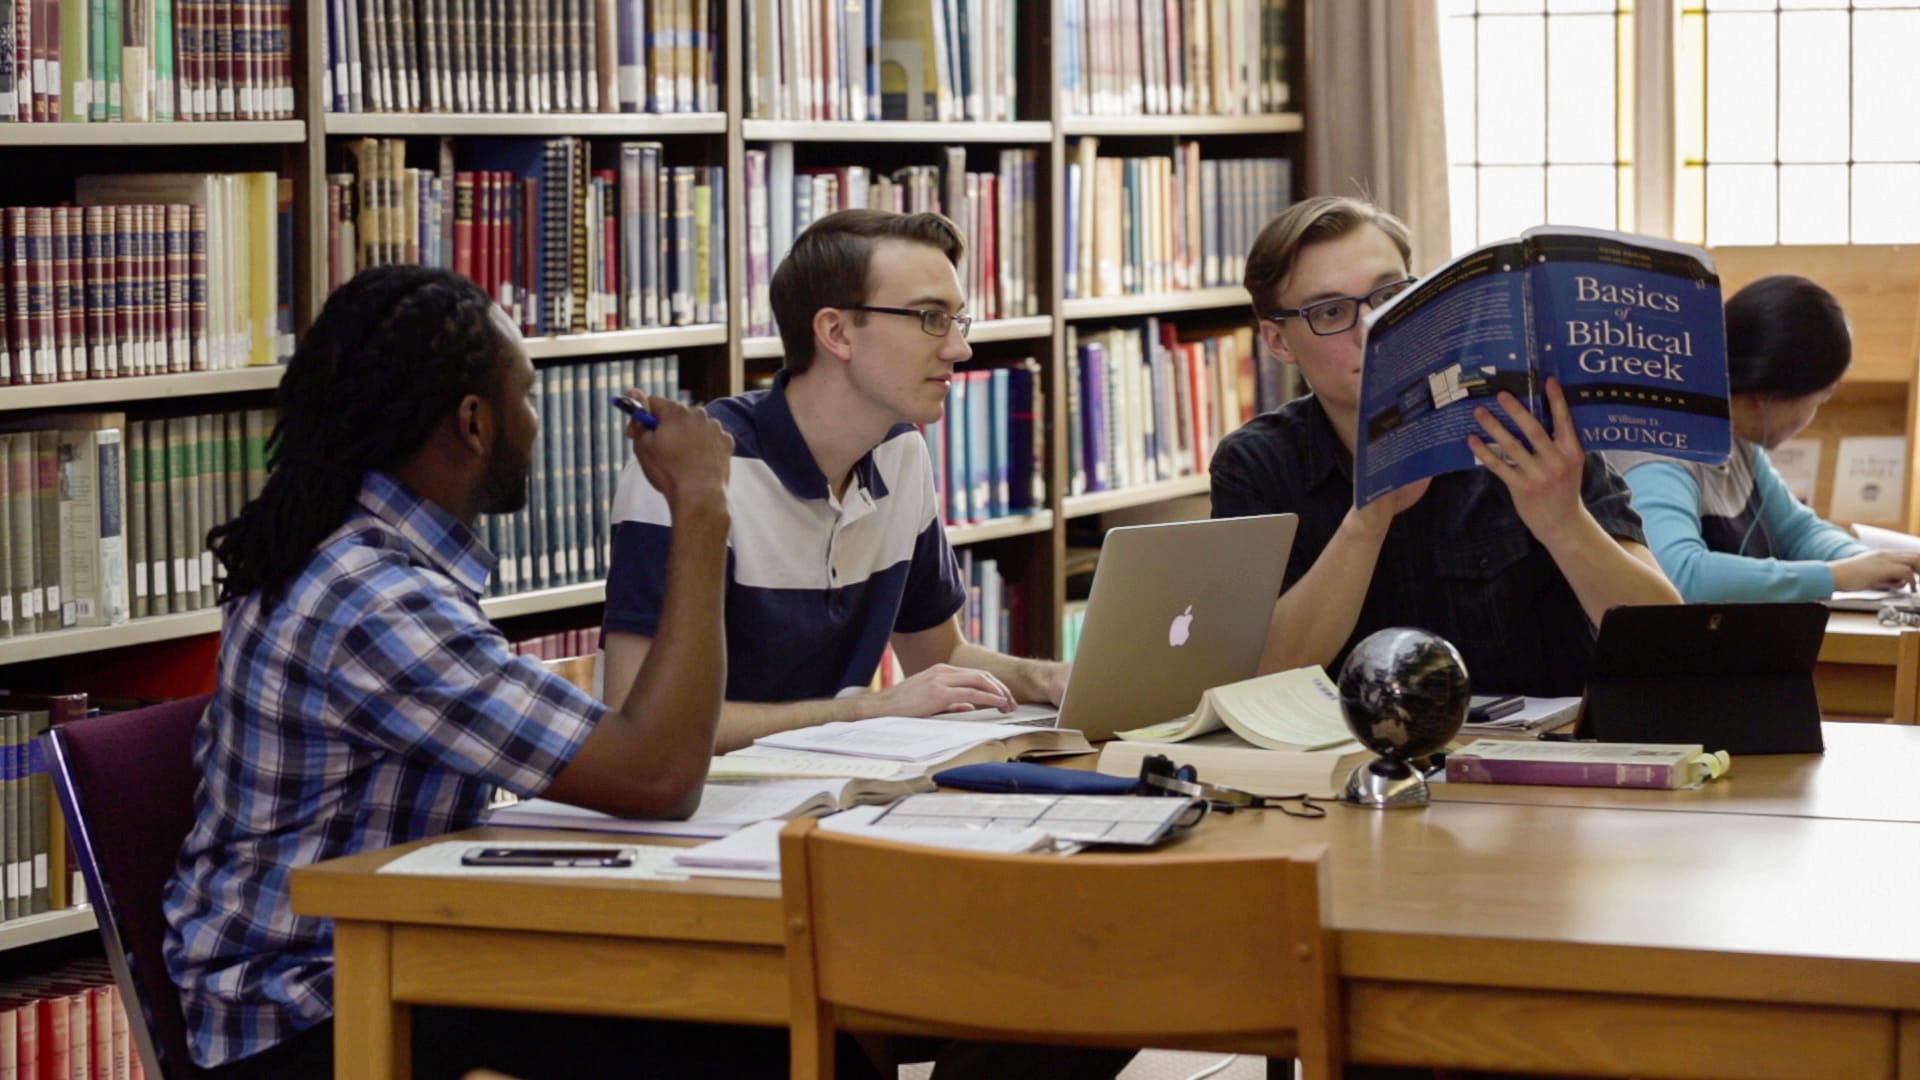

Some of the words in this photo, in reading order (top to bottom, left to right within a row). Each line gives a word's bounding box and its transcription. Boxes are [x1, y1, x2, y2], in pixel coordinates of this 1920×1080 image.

[1574, 276, 1681, 313] Basics
[1614, 307, 1632, 320] of
[1565, 319, 1694, 357] Biblical
[1578, 348, 1685, 382] Greek
[1579, 389, 1686, 404] WORKBOOK
[1607, 414, 1647, 426] William
[1582, 426, 1689, 449] MOUNCE
